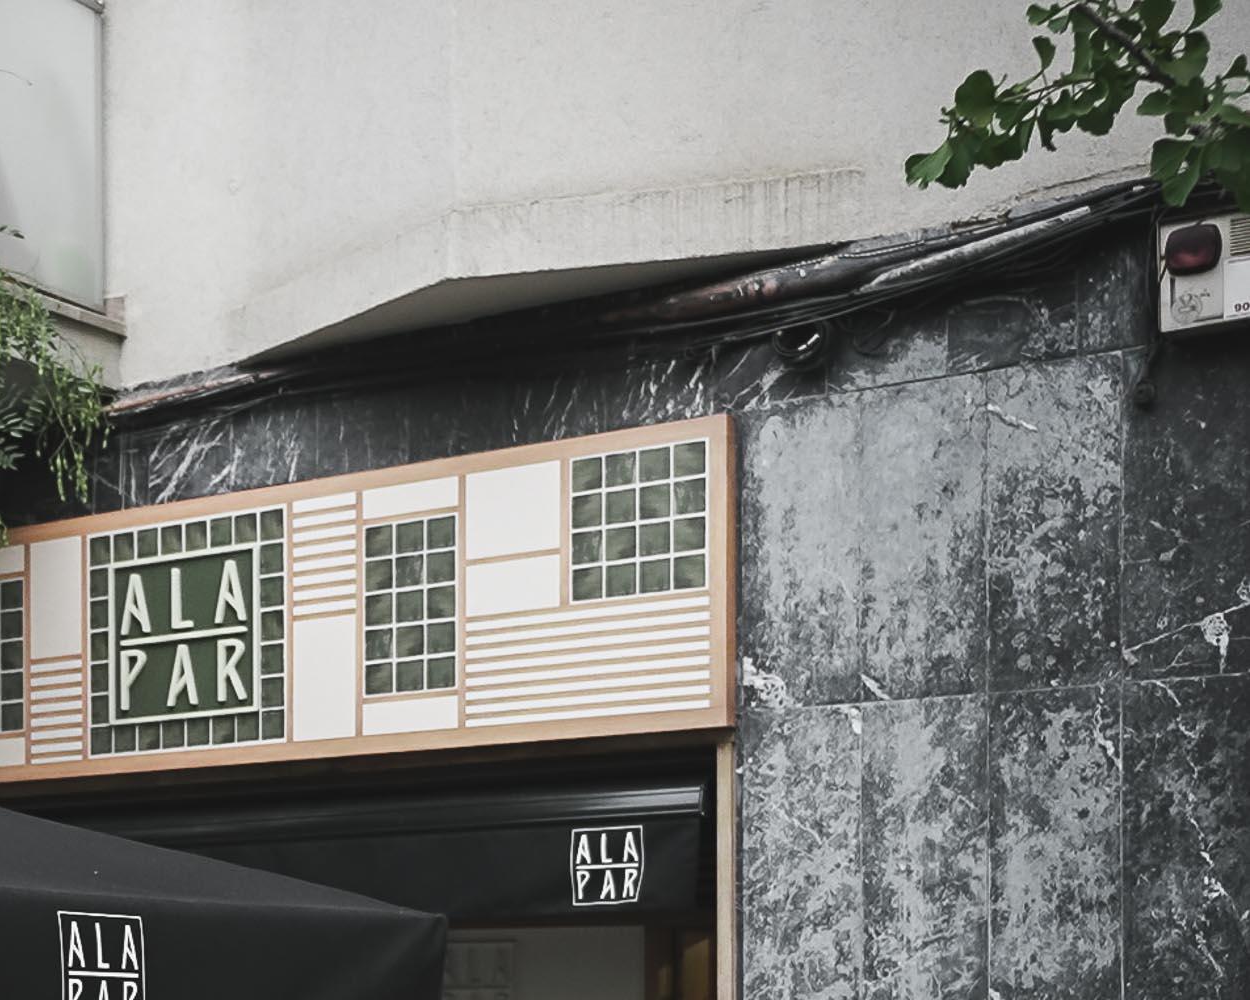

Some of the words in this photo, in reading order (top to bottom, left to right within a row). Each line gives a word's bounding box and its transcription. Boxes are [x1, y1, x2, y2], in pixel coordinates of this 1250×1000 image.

[120, 559, 247, 636] ALA
[120, 637, 248, 711] PAR
[575, 831, 640, 865] ALA
[575, 869, 639, 900] PAR
[67, 920, 139, 971] ALA
